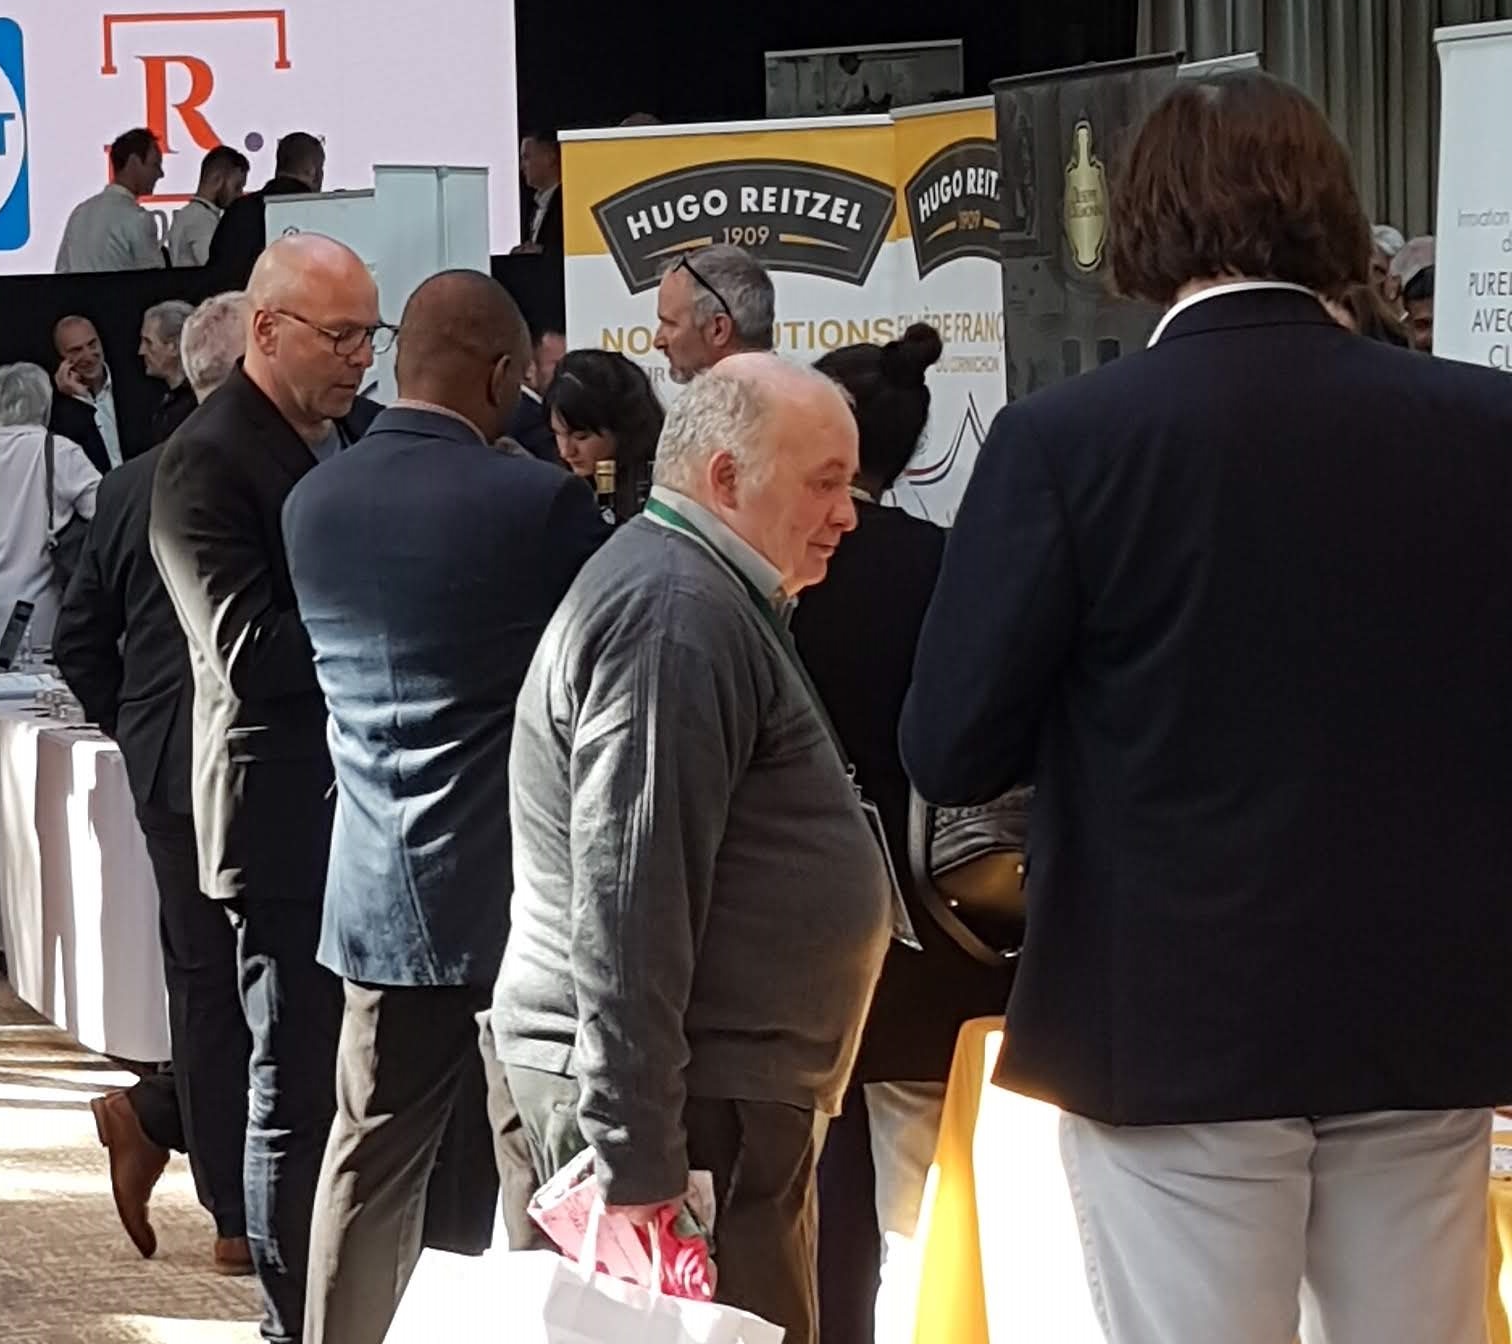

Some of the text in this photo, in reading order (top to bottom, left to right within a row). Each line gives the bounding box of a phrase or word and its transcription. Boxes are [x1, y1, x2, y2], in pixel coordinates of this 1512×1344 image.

[626, 187, 863, 240] HUGO REITZEL
[918, 167, 1001, 223] HUGO REIT
[723, 226, 770, 247] 1909
[602, 325, 651, 355] NO
